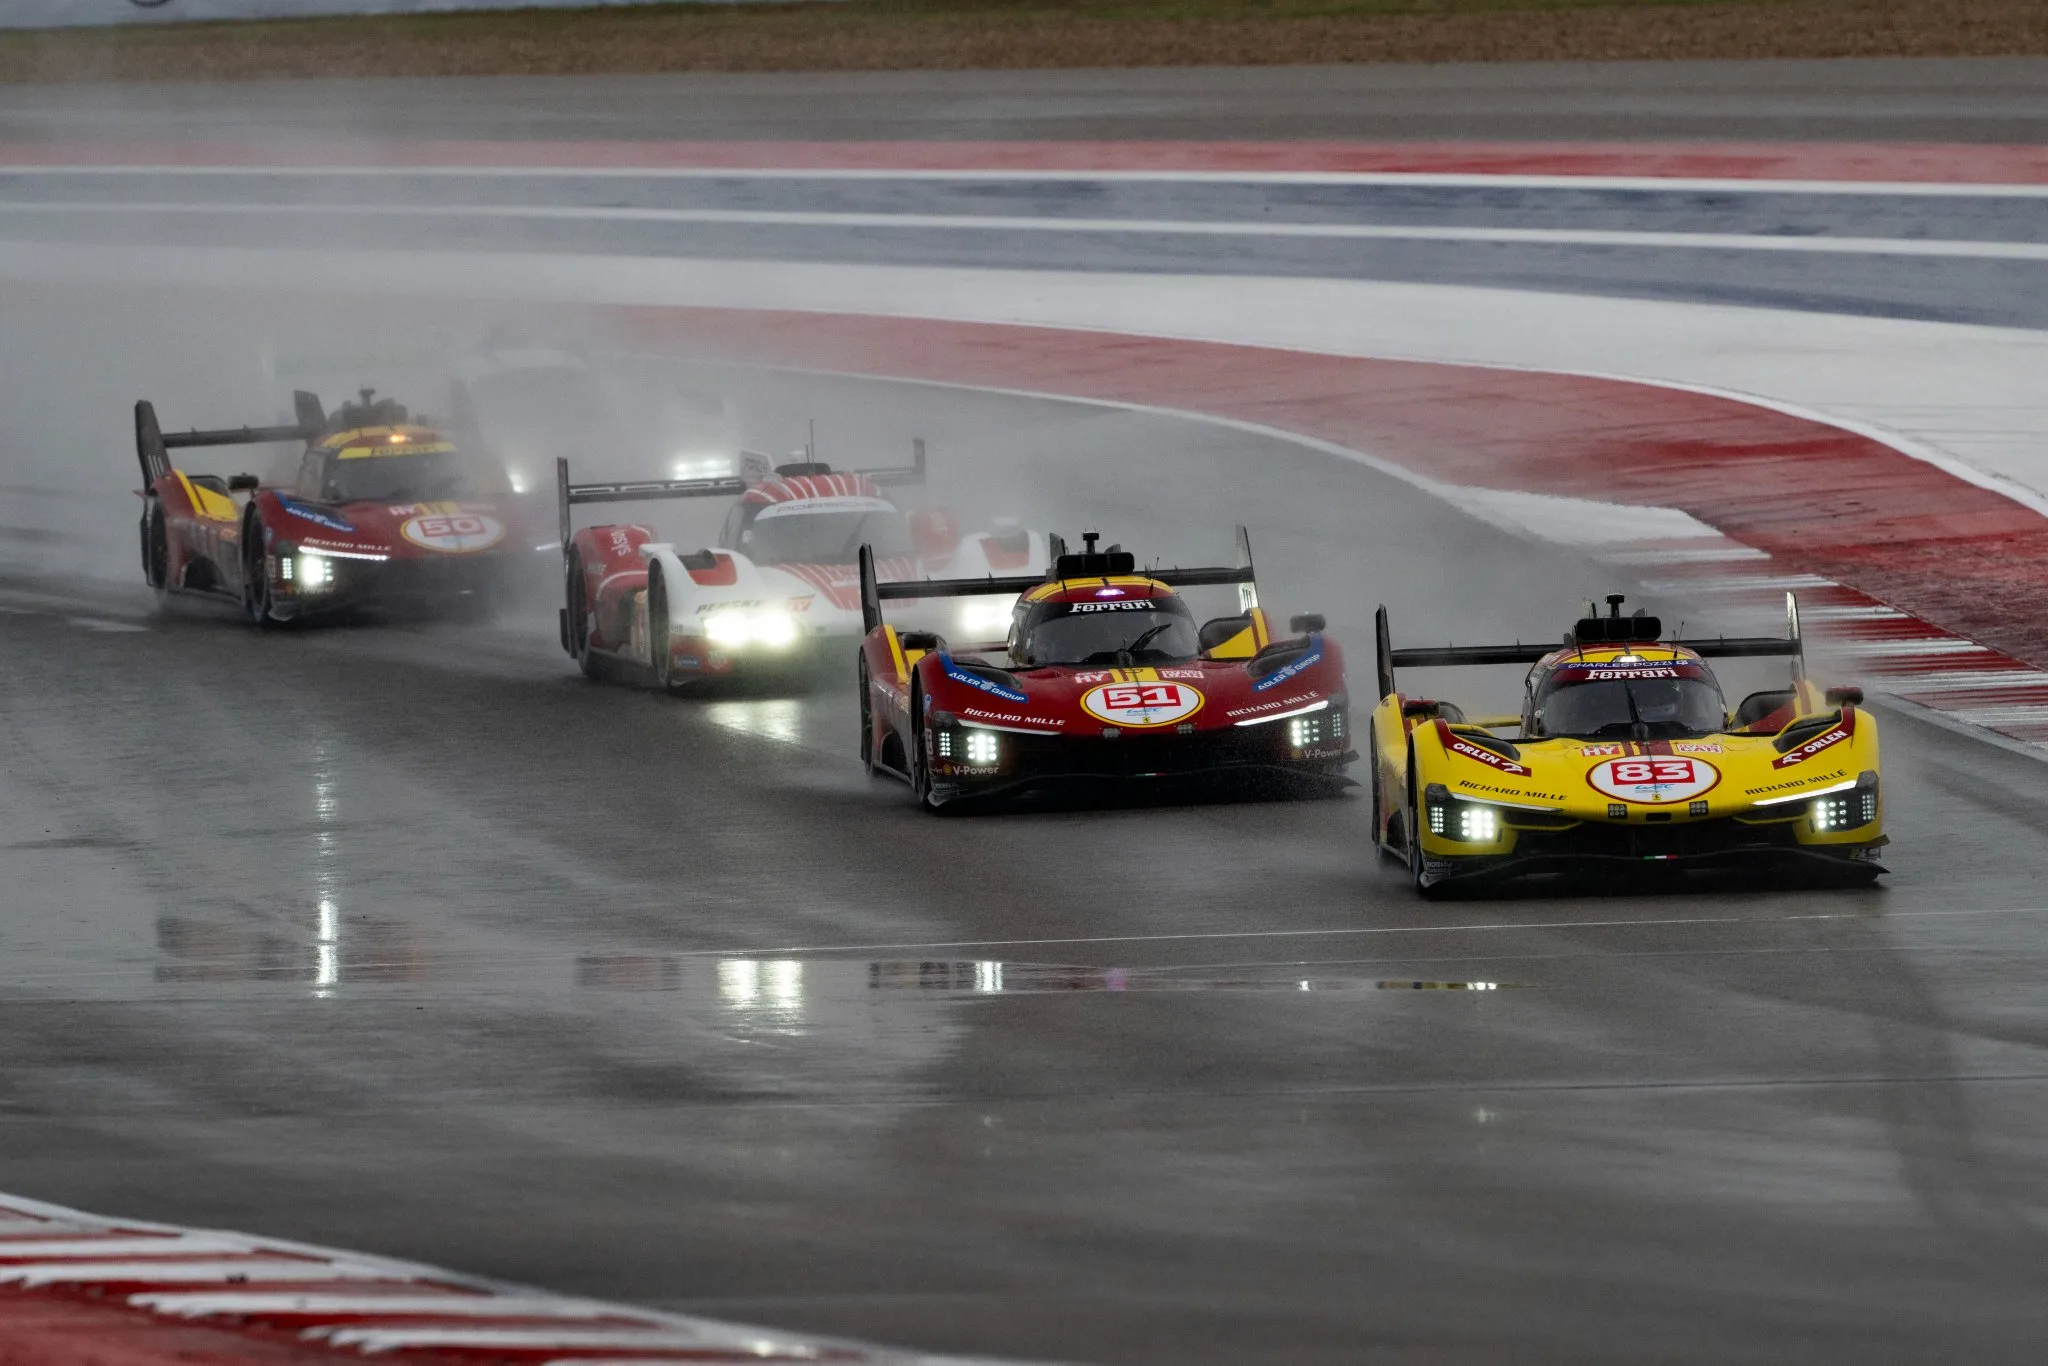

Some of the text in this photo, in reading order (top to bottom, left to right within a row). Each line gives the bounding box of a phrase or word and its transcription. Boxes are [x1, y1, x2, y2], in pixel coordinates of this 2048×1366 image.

[422, 518, 474, 536] 50
[303, 536, 392, 552] RICHARD MILLE
[1069, 599, 1156, 613] Ferrari
[1258, 653, 1321, 690] ADLER GROUP
[1568, 660, 1631, 668] CHARLES
[1074, 673, 1105, 684] HY
[1584, 667, 1679, 680] Ferrari
[949, 672, 1025, 701] ADLER GROUP
[1107, 688, 1177, 706] 51
[1226, 690, 1320, 716] RICHARD MILLE
[964, 707, 1066, 726] RICHARD MILLE
[1803, 730, 1848, 753] ORLEN
[1453, 742, 1501, 764] ORLEN
[1582, 745, 1618, 757] HY
[952, 765, 999, 776] V-Power
[1616, 763, 1690, 781] 83
[1459, 780, 1568, 801] RICHARD MILLE
[1745, 768, 1848, 796] RICHARD MILLE
